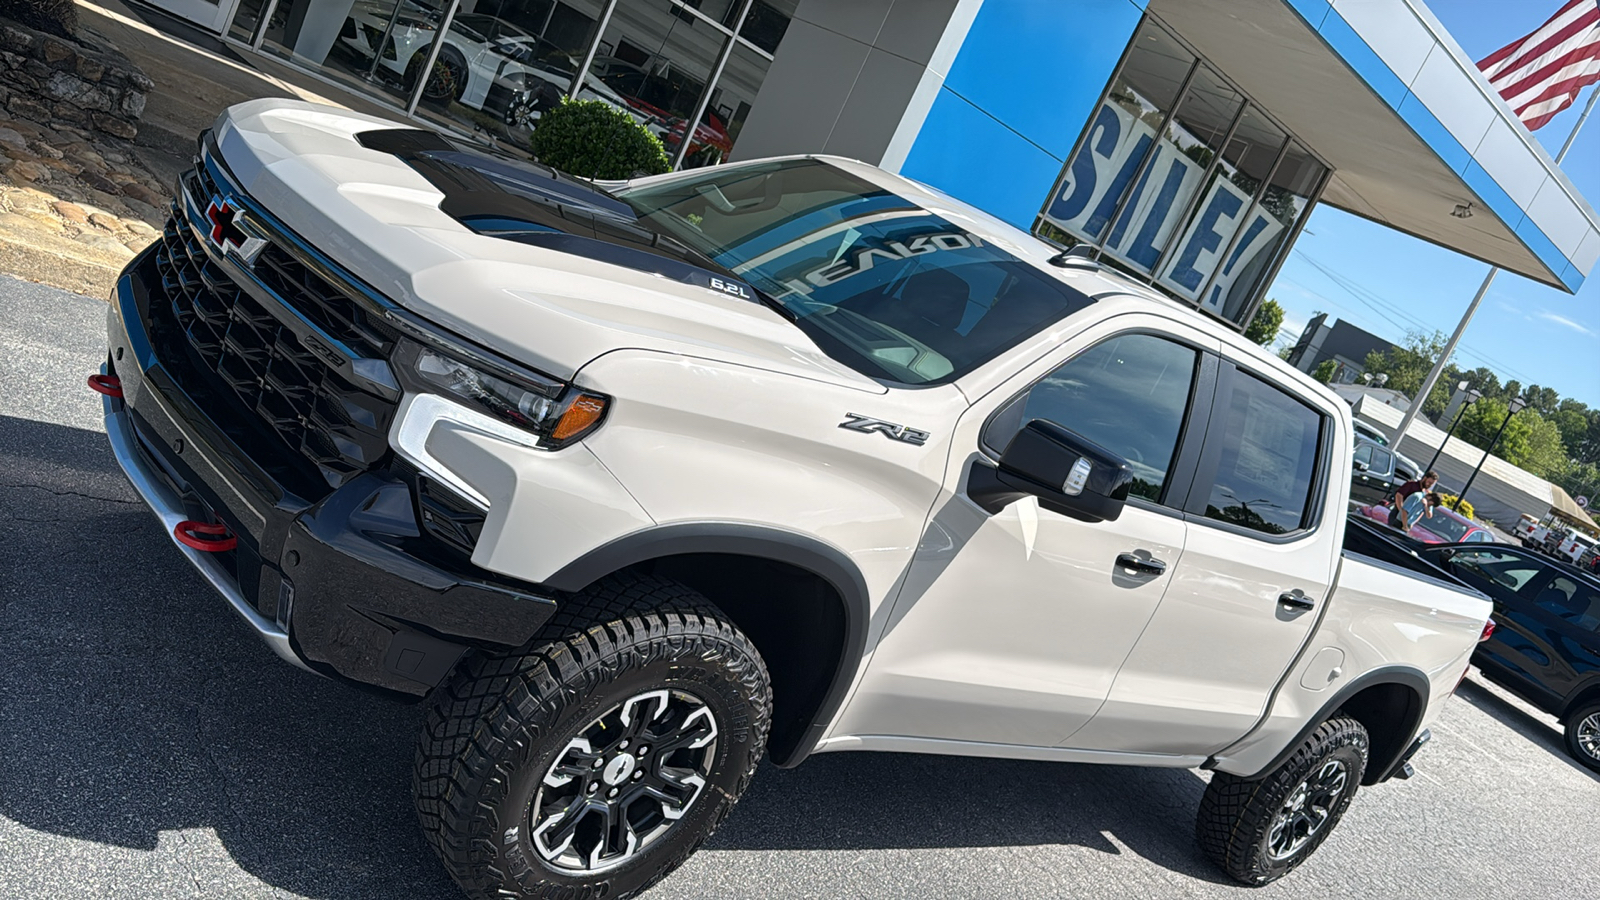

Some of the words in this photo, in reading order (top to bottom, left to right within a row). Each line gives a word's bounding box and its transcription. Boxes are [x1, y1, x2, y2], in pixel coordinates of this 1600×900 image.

[1048, 104, 1269, 307] SALE!
[709, 277, 751, 299] 6.2L
[838, 411, 931, 447] ZR2
